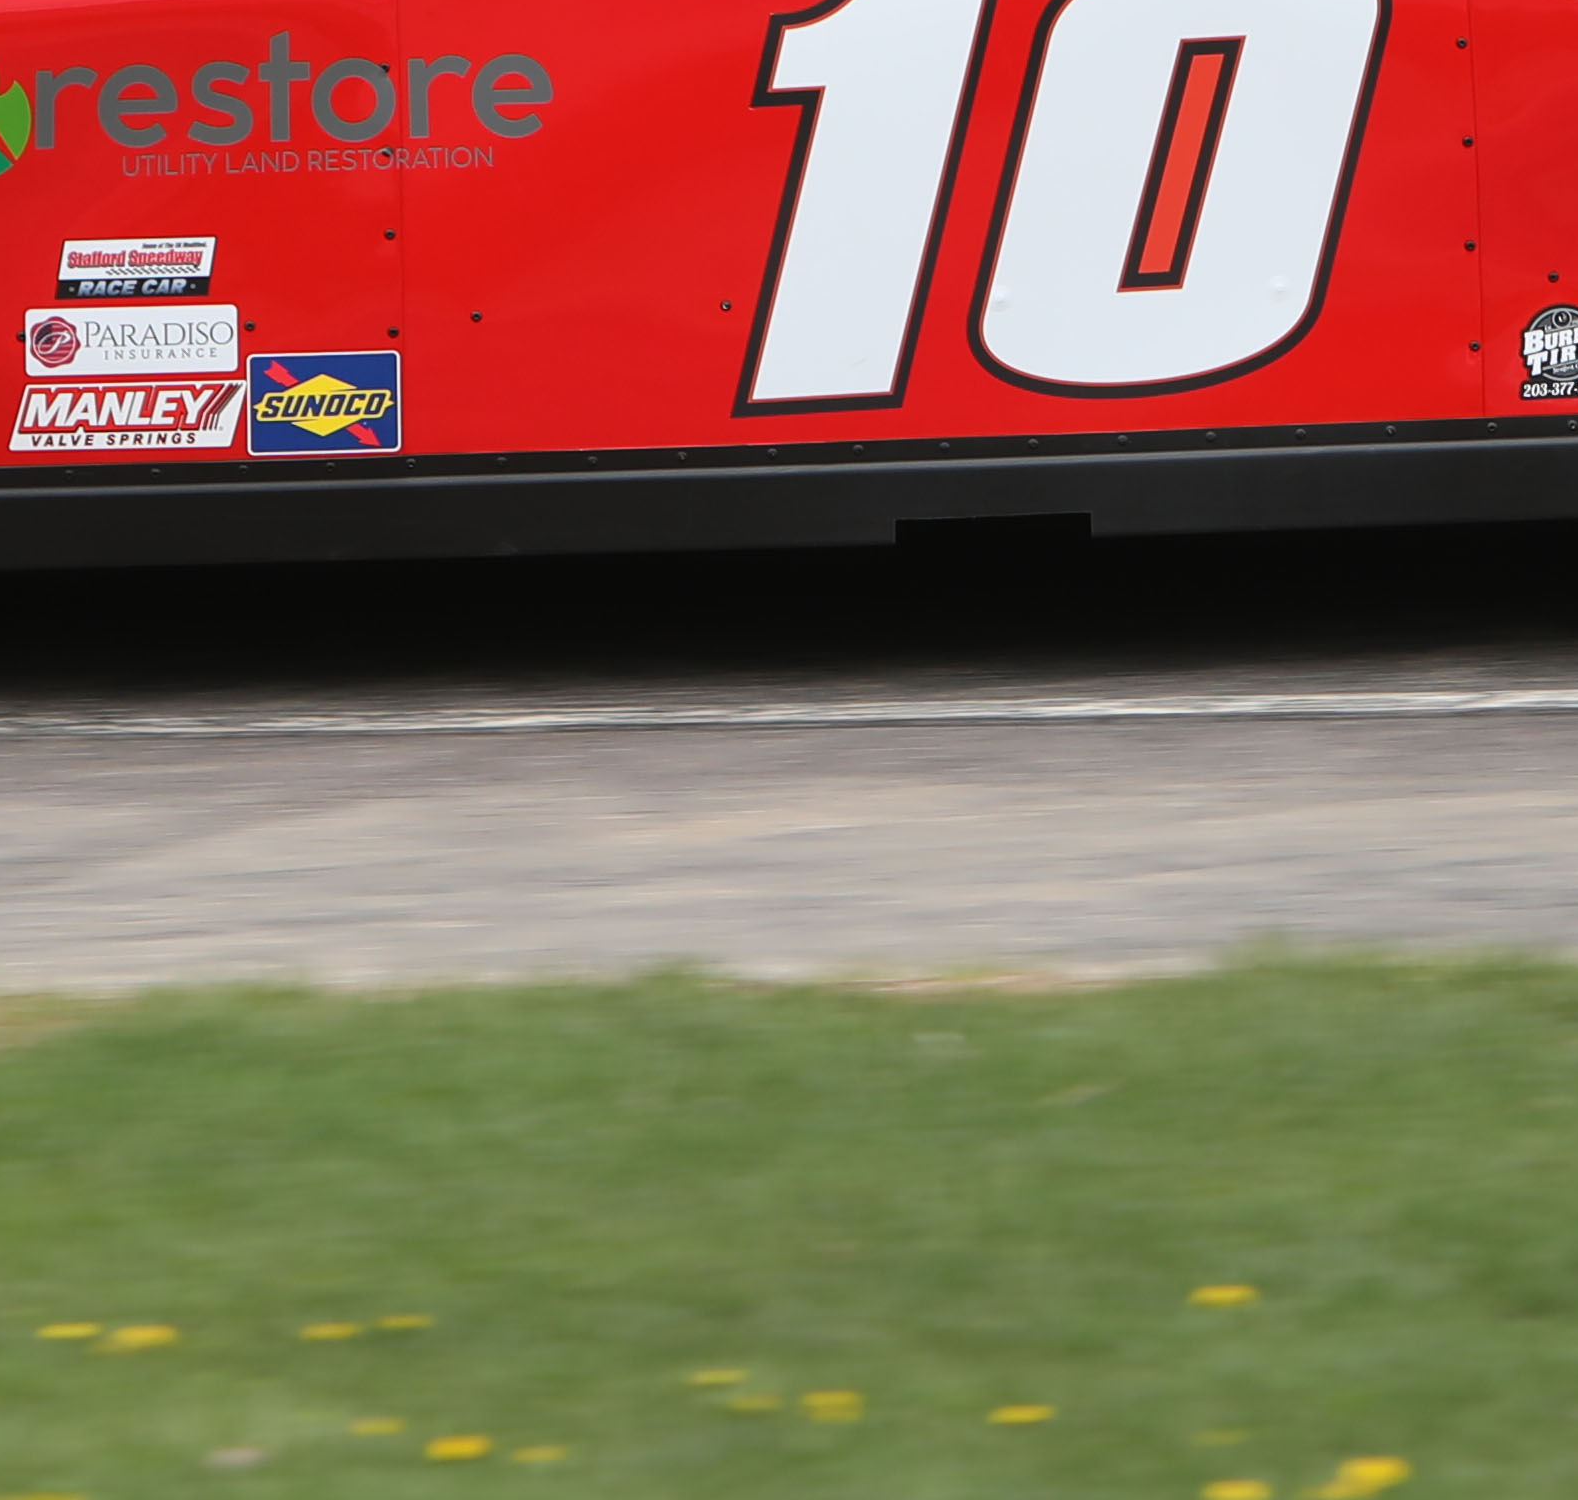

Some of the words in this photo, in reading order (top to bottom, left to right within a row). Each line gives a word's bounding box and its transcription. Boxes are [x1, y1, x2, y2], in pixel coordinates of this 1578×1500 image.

[34, 30, 554, 149] restore
[122, 152, 218, 176] UTILITY
[225, 150, 300, 173] LAND
[308, 145, 495, 172] RESTORATION
[67, 250, 126, 268] Stafford
[128, 249, 203, 267] Speedway
[77, 280, 137, 297] RACE
[141, 278, 187, 295] CAR
[84, 320, 234, 348] PARADISO
[104, 348, 218, 360] INSURANCE
[22, 386, 213, 429] MANLEY
[262, 392, 388, 418] SUNOCO
[31, 434, 94, 447] VALVE
[107, 432, 197, 445] SPRINGS
